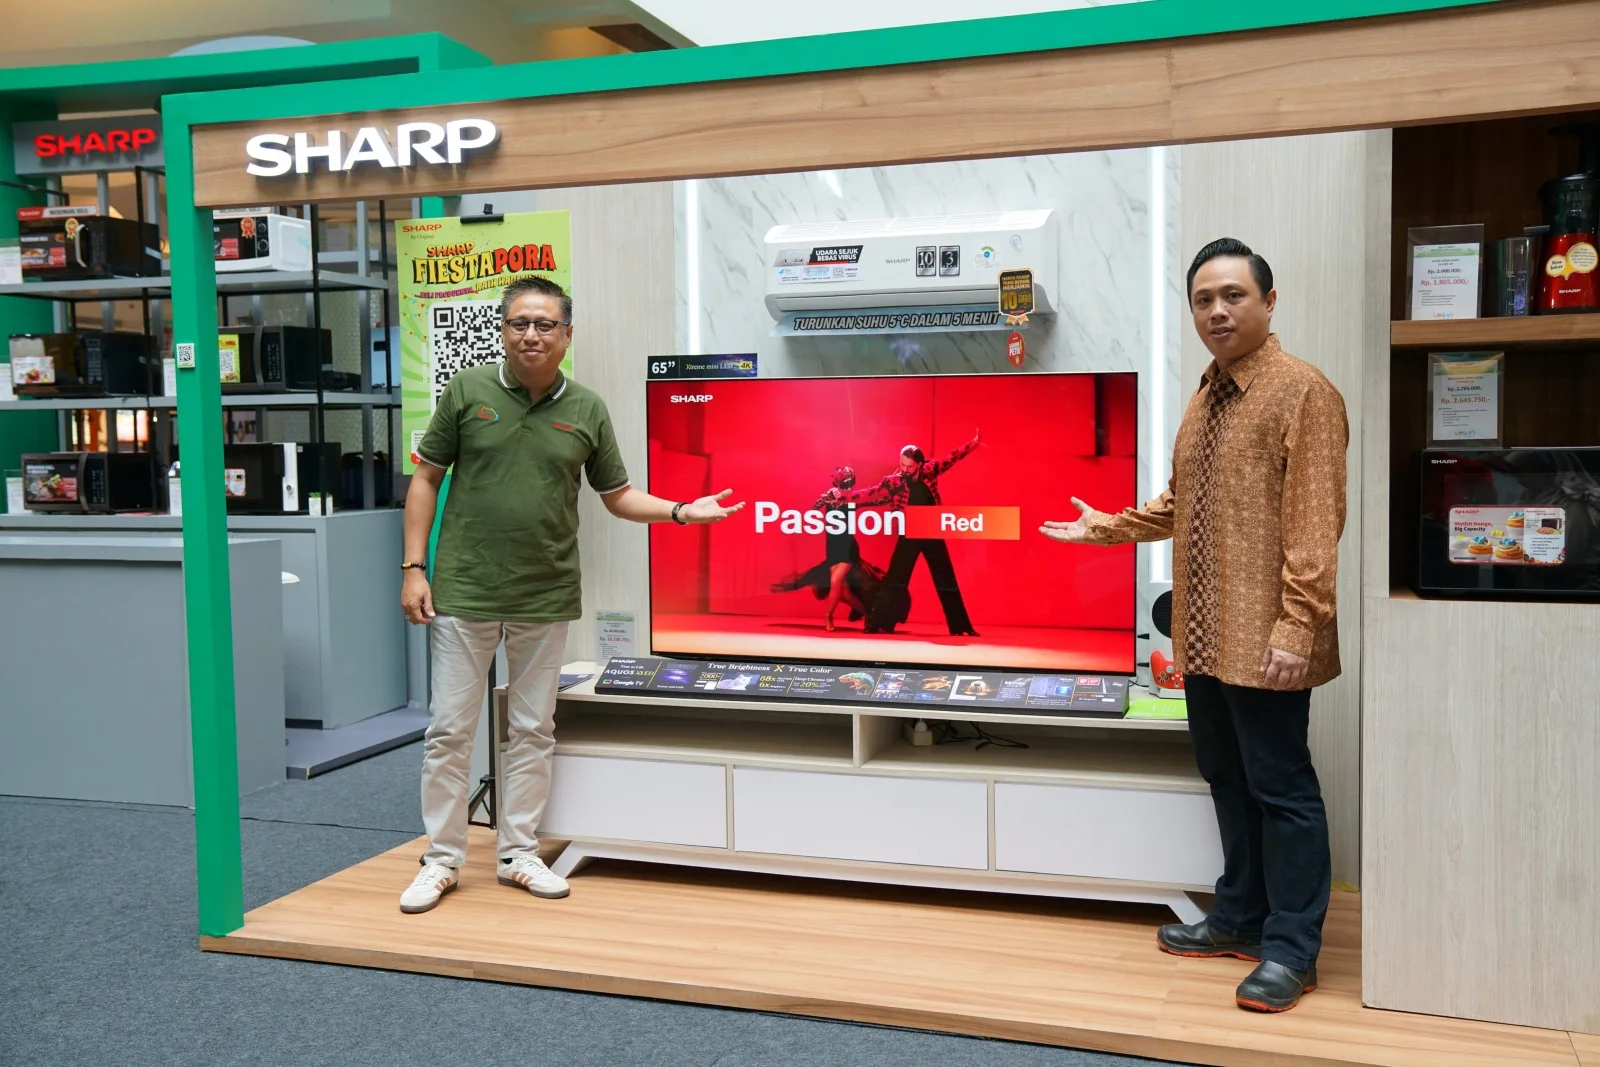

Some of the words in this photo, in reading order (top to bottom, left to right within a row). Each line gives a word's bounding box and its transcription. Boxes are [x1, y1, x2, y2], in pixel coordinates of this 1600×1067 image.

[34, 128, 156, 158] SHARP
[246, 118, 497, 177] SHARP
[402, 224, 442, 232] SHARP
[427, 241, 475, 257] SHARP
[918, 251, 934, 266] 10
[945, 251, 954, 266] 3
[476, 279, 497, 291] RAIH
[1002, 291, 1018, 310] 10
[794, 316, 856, 330] TURUNKAN
[856, 315, 888, 329] SUHU
[910, 313, 951, 327] DALAM
[952, 313, 962, 326] 5
[961, 311, 1001, 325] MENIT
[670, 394, 713, 403] SHARP
[754, 501, 906, 536] Passion
[940, 513, 984, 532] Red
[707, 662, 726, 670] True
